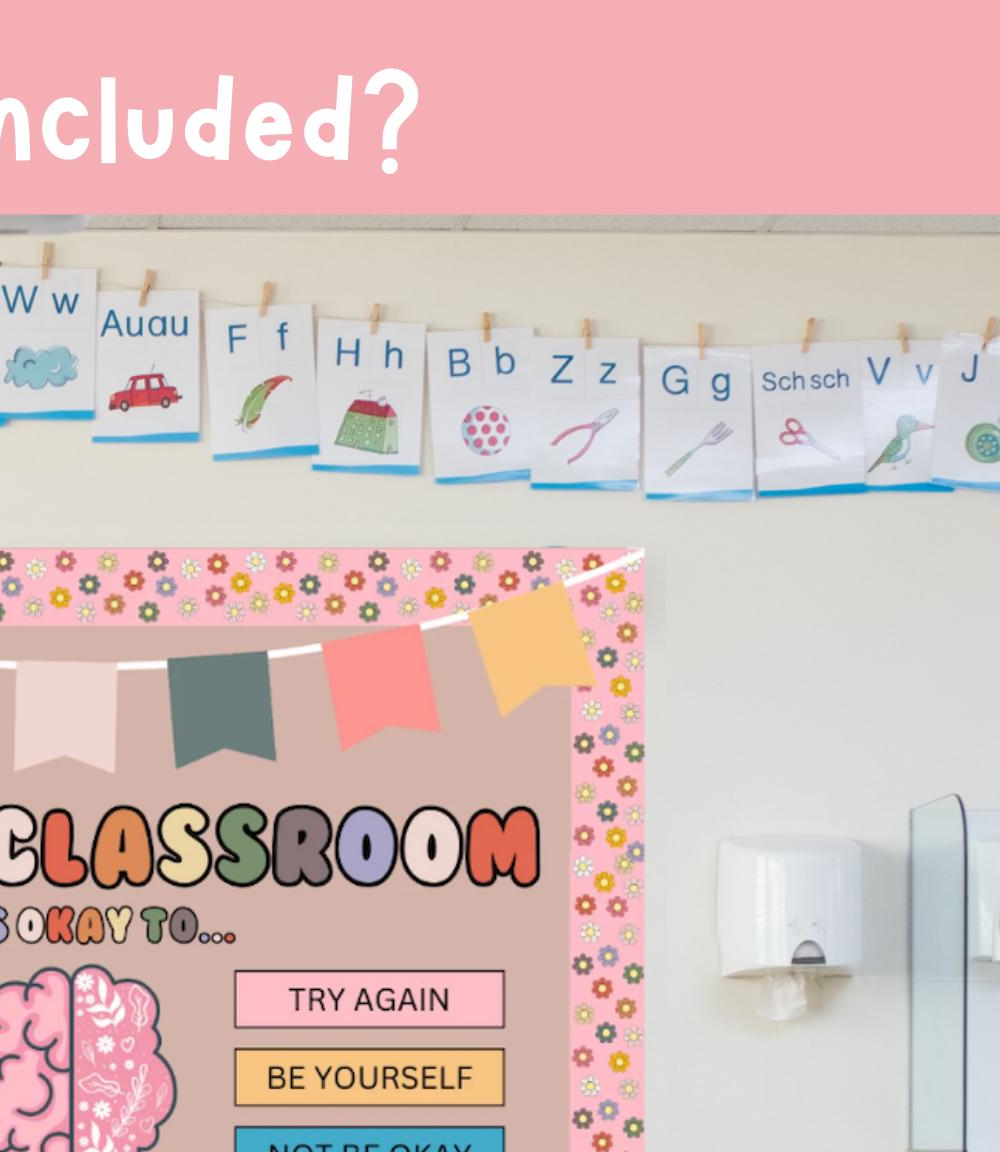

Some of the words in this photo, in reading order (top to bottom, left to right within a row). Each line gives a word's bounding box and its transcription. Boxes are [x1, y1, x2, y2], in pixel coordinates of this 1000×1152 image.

[1, 285, 39, 315] W
[52, 292, 80, 316] w
[227, 323, 248, 354] F
[277, 320, 289, 350] f
[335, 336, 362, 367] H
[383, 340, 404, 370] h
[448, 347, 473, 379] B
[495, 345, 518, 376] b
[551, 353, 576, 385] Z
[598, 360, 618, 386] z
[866, 356, 892, 386] V
[915, 363, 935, 386] v
[960, 353, 980, 385] J
[660, 363, 691, 397] G
[710, 370, 733, 403] g
[761, 370, 805, 392] Sch
[810, 368, 850, 391] sch
[15, 905, 134, 946] OKAY
[139, 906, 236, 945] TO...
[288, 987, 345, 1012] TRY
[354, 987, 449, 1012] AGAIN
[267, 1065, 305, 1090] BE
[314, 1065, 473, 1090] YOURSELF
